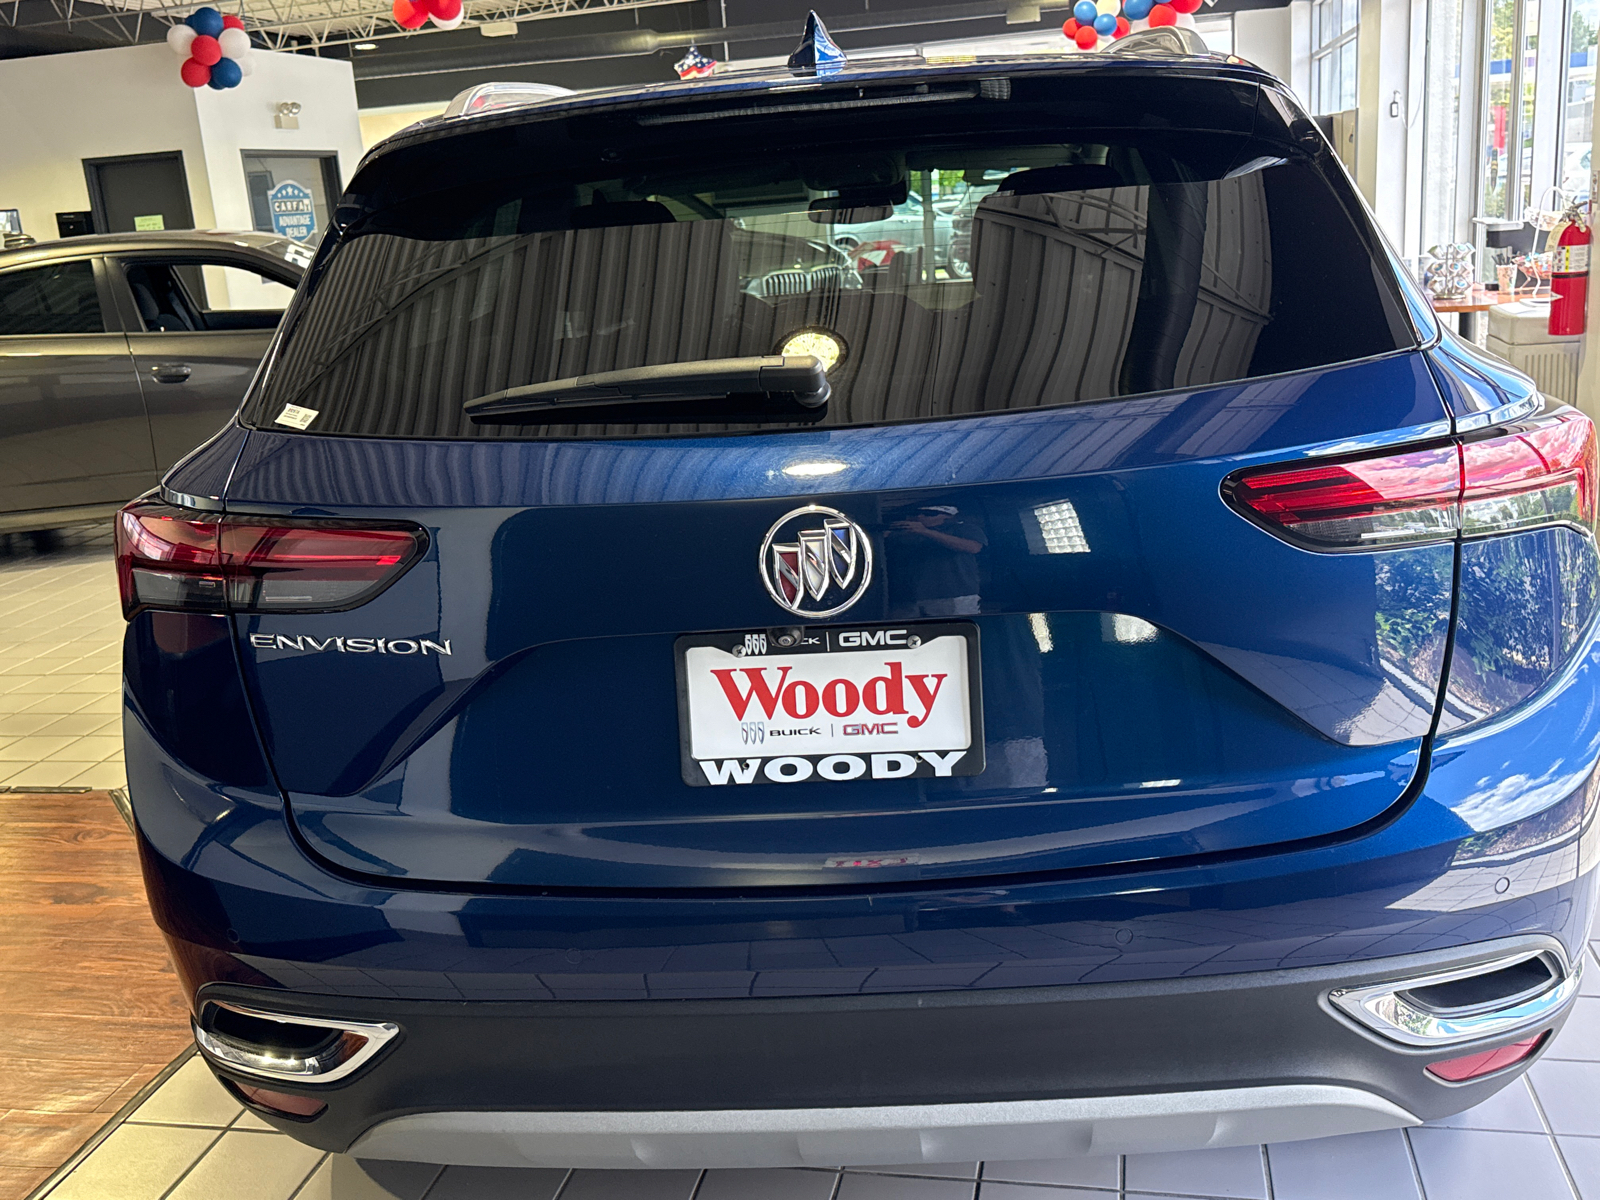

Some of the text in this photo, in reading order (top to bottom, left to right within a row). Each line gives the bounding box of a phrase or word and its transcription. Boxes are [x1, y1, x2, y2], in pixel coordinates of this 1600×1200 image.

[279, 214, 311, 227] ADVANTAGE
[286, 226, 307, 237] DEALER
[250, 633, 452, 656] ENVISION
[838, 629, 908, 648] GMC
[710, 661, 948, 729] Woody
[769, 722, 899, 737] BUICK GMC
[699, 750, 968, 786] WOODY
